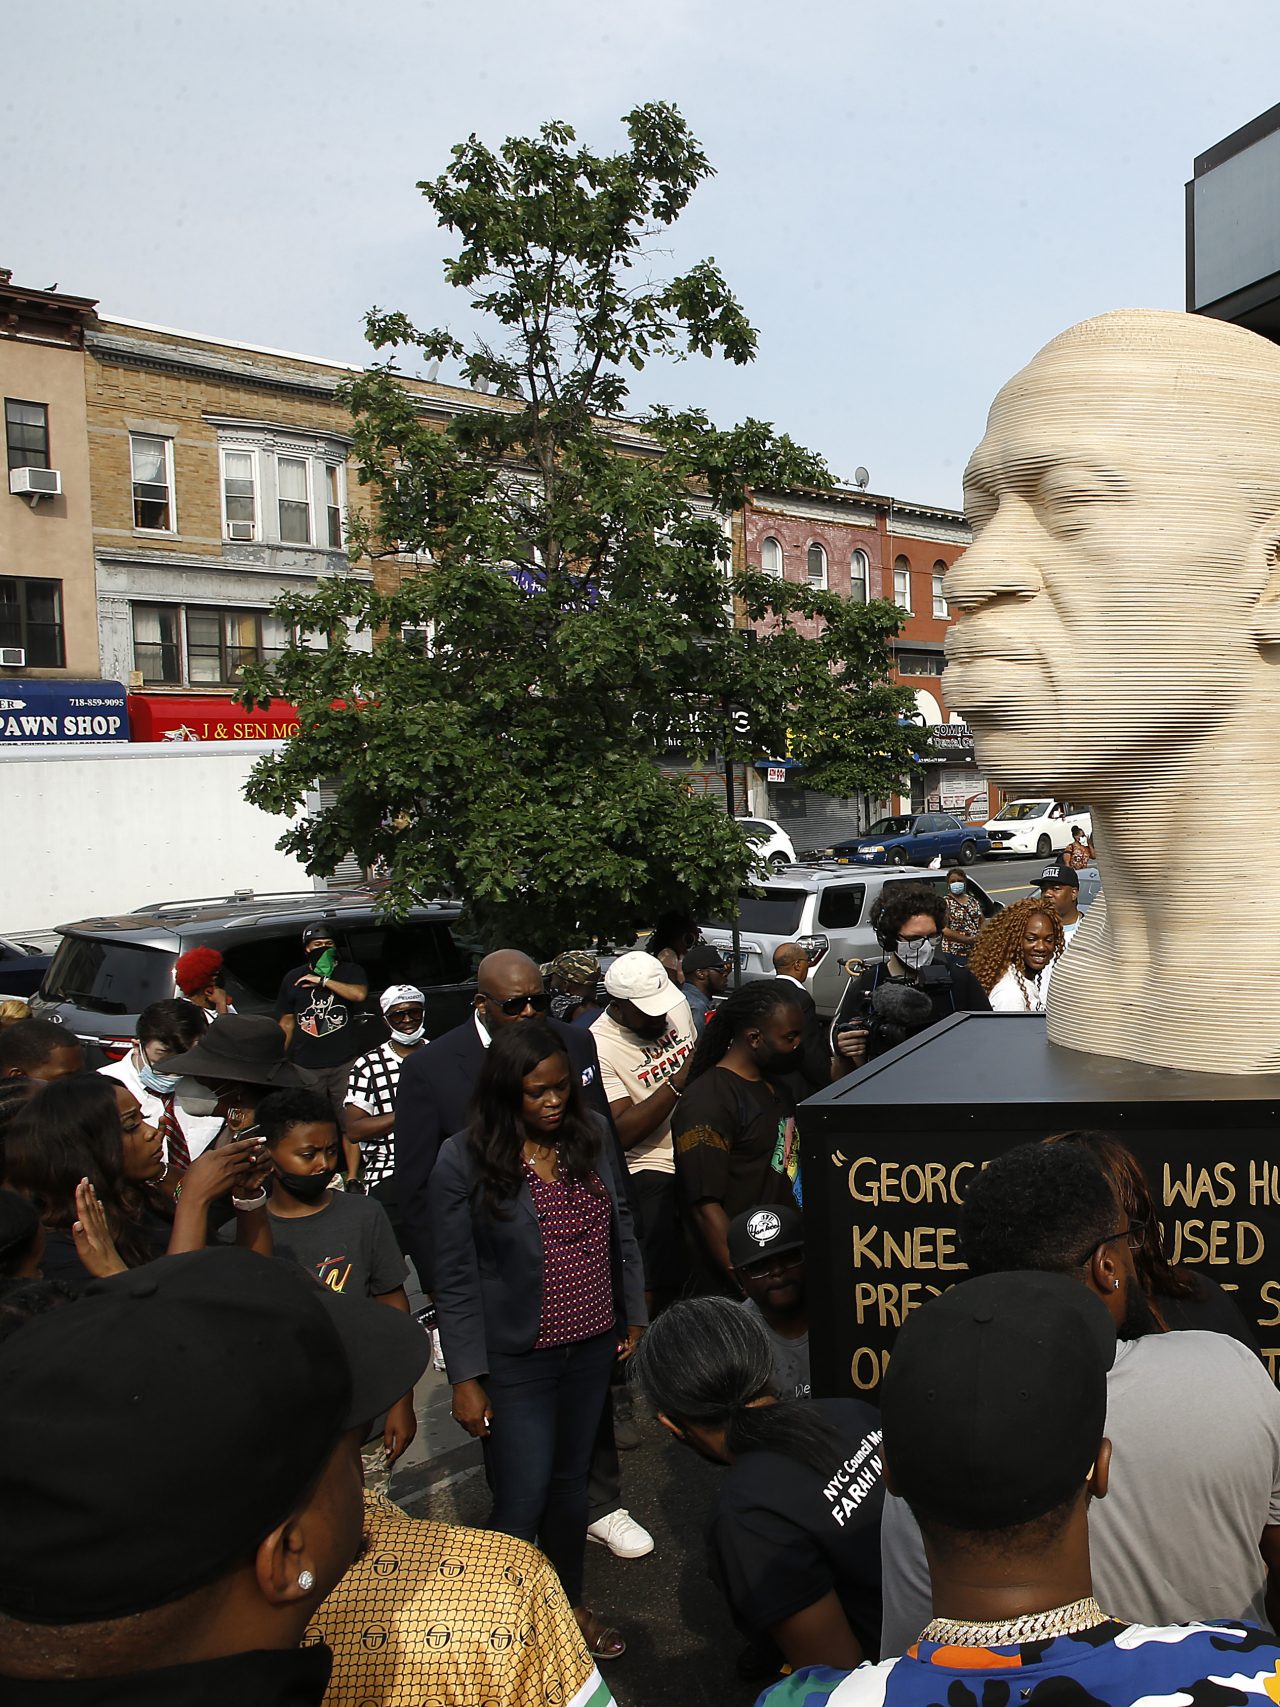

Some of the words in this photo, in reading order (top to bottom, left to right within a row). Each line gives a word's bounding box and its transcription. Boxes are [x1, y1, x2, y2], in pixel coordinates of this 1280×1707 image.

[69, 698, 124, 707] 718-859-9095
[63, 716, 121, 736] SHOP
[202, 723, 209, 739] J
[214, 723, 229, 739] &
[233, 723, 267, 739] SEN
[933, 724, 973, 736] COMPL
[640, 1029, 680, 1065] JUNE
[1162, 1161, 1236, 1208] WAS
[1159, 1219, 1265, 1267] USED
[823, 1469, 850, 1503] NYC
[843, 1438, 873, 1474] Council
[866, 1428, 884, 1447] Me
[831, 1467, 877, 1527] FARAH
